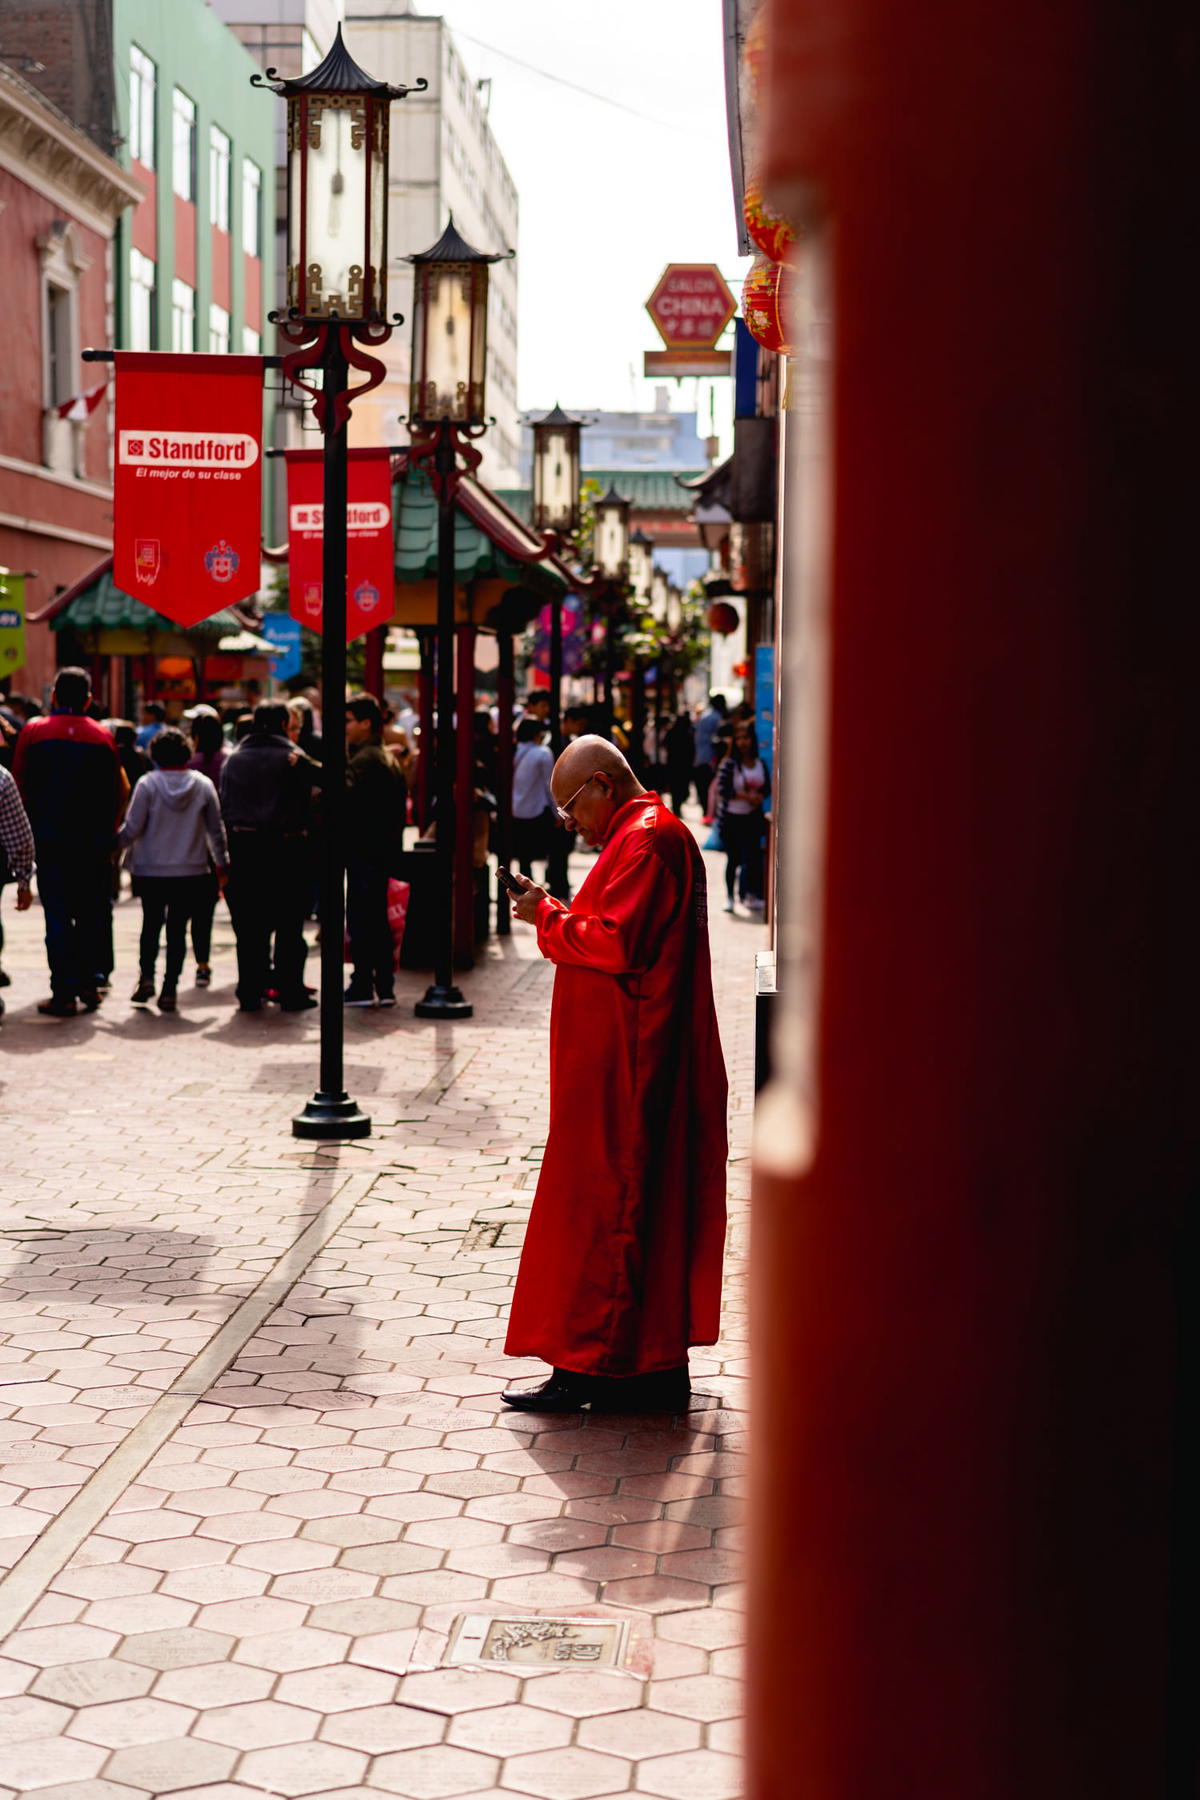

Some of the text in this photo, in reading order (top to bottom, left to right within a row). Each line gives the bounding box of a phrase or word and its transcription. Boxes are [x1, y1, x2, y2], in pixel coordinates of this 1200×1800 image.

[656, 296, 726, 317] CHINA
[148, 438, 246, 461] Standford
[136, 467, 242, 481] El mejor de su clase
